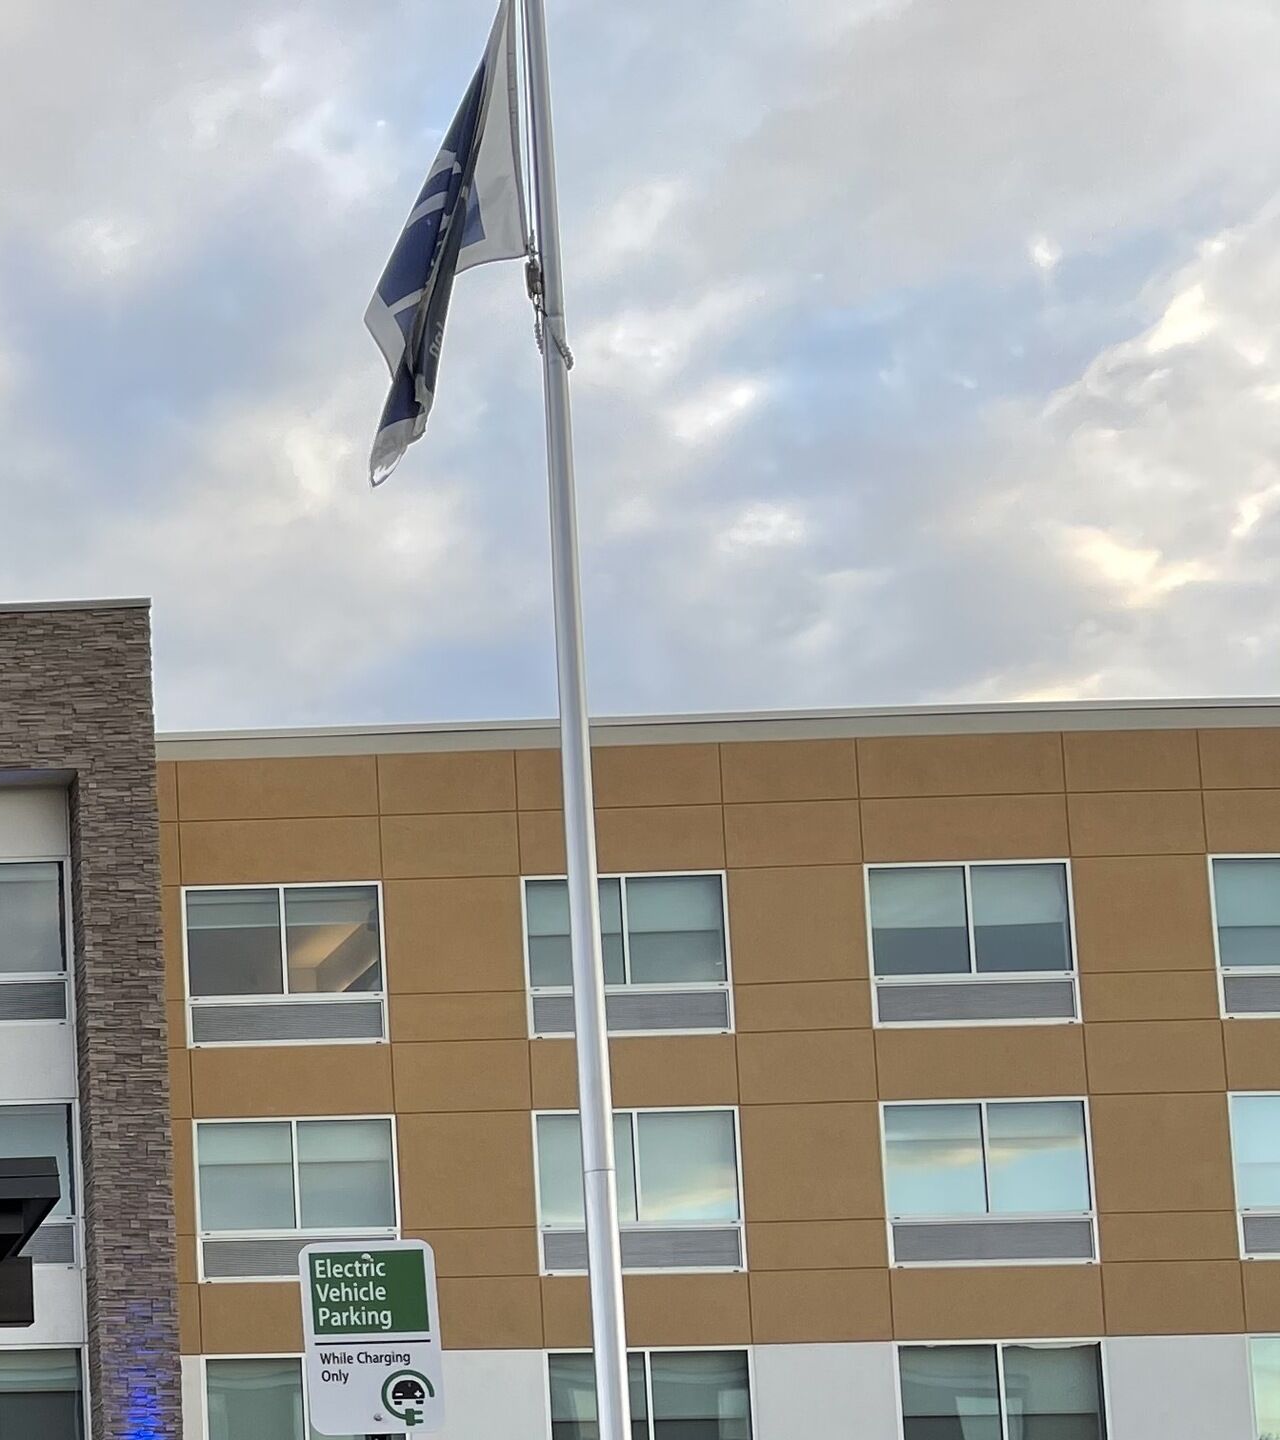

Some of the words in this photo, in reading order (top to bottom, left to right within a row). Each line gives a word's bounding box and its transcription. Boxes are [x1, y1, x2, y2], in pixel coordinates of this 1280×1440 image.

[315, 1258, 386, 1279] Electric
[316, 1281, 387, 1302] Vehicle
[318, 1306, 392, 1330] Parking
[320, 1352, 354, 1365] While
[357, 1351, 411, 1367] Charging
[321, 1369, 349, 1385] Only
